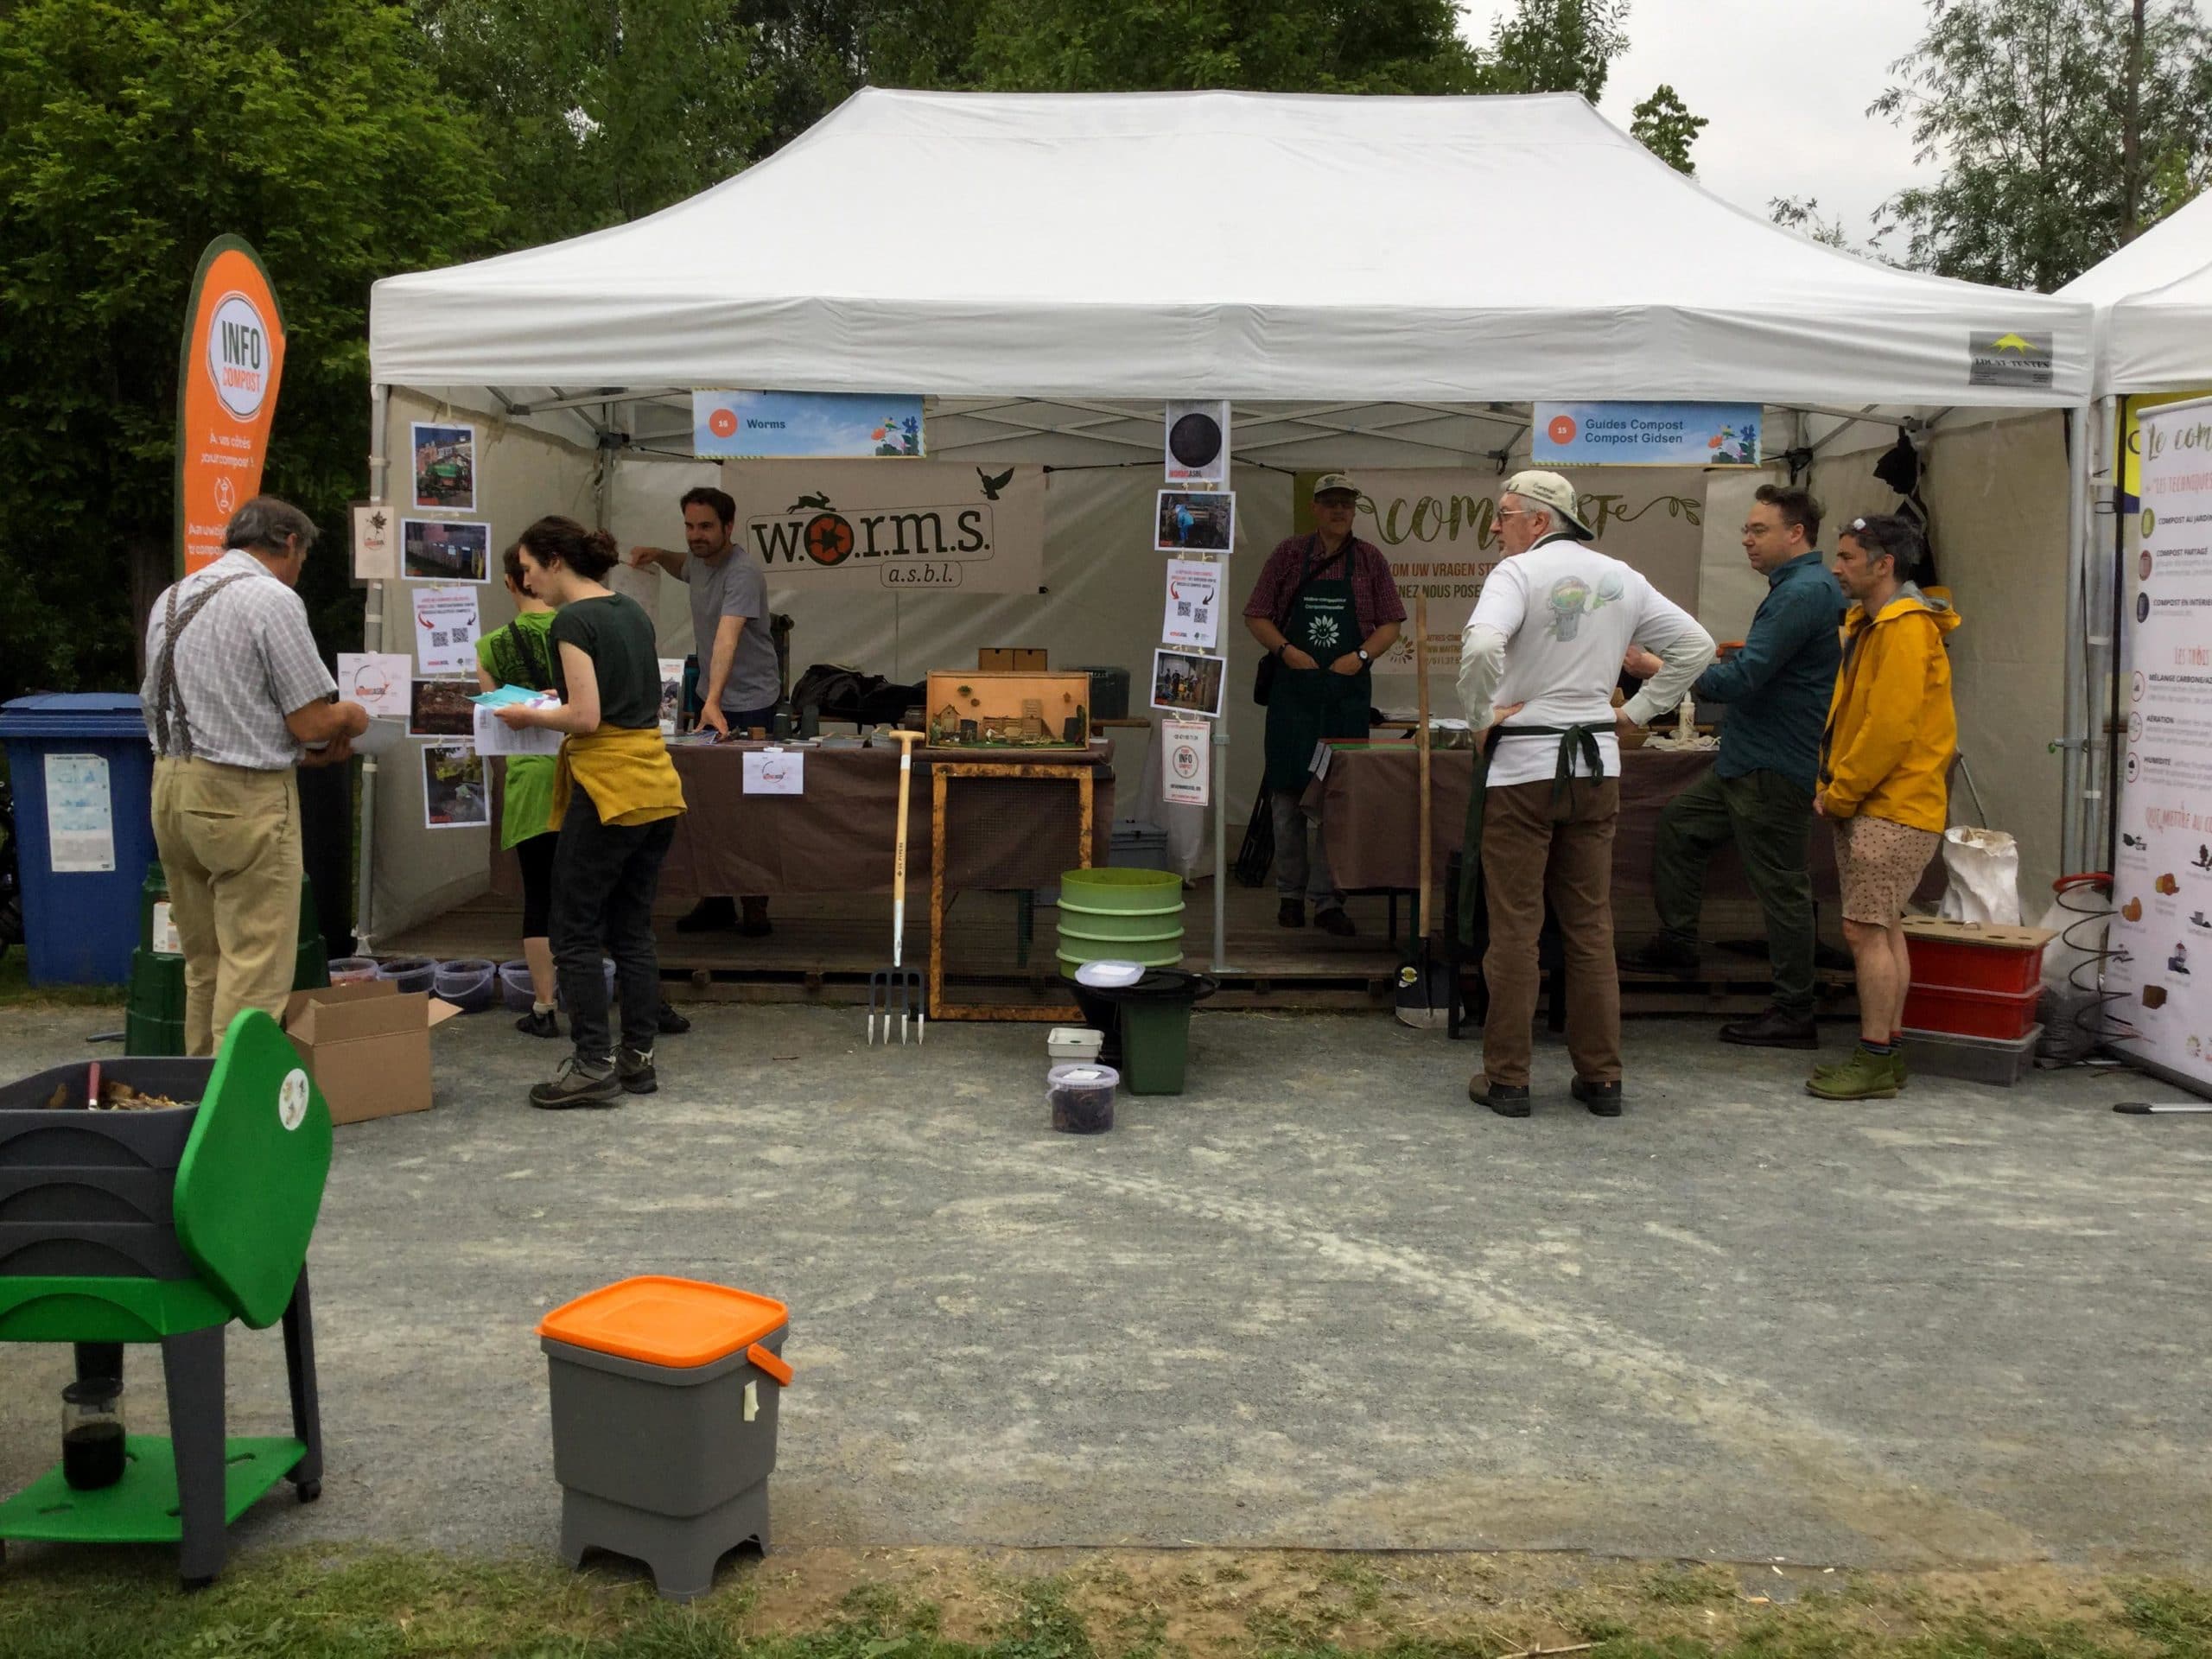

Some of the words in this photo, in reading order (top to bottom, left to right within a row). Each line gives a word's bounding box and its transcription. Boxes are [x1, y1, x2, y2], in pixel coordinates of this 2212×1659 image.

[222, 321, 261, 370] INFO
[222, 366, 261, 393] COMPOST
[747, 419, 786, 429] Worms
[1586, 418, 1626, 429] Guides
[1630, 418, 1684, 430] Compost
[1585, 433, 1638, 445] Compost
[1642, 433, 1683, 443] Gidsen
[888, 563, 953, 582] a.s.b.l.
[1412, 563, 1430, 577] UW
[1432, 563, 1475, 577] VRAGEN
[1397, 584, 1420, 599] NEZ
[1422, 585, 1451, 599] NOUS
[1453, 585, 1484, 599] POSE
[1179, 753, 1192, 764] INFO
